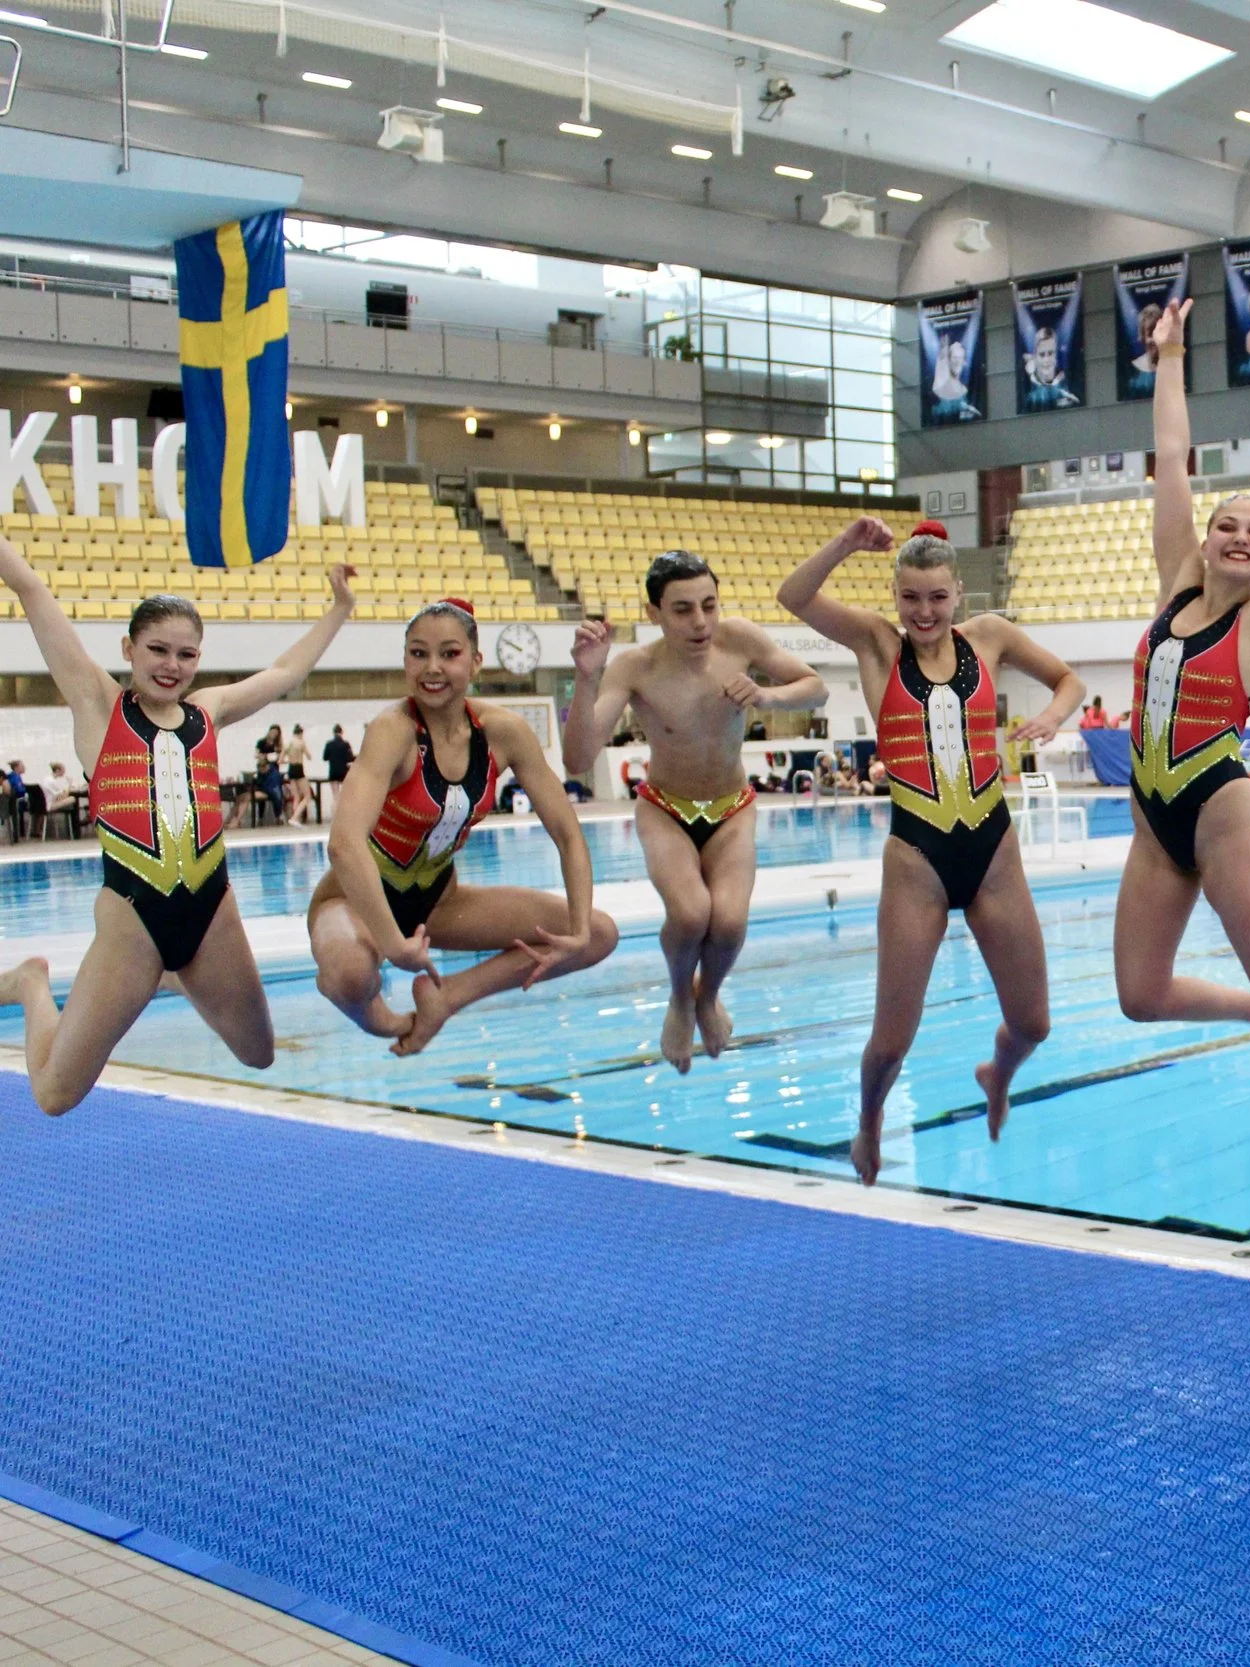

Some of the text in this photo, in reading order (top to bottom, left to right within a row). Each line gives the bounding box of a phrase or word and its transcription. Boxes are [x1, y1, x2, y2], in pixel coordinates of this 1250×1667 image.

[1144, 267, 1156, 277] OF
[1159, 262, 1183, 274] FAME
[1041, 285, 1052, 295] OF
